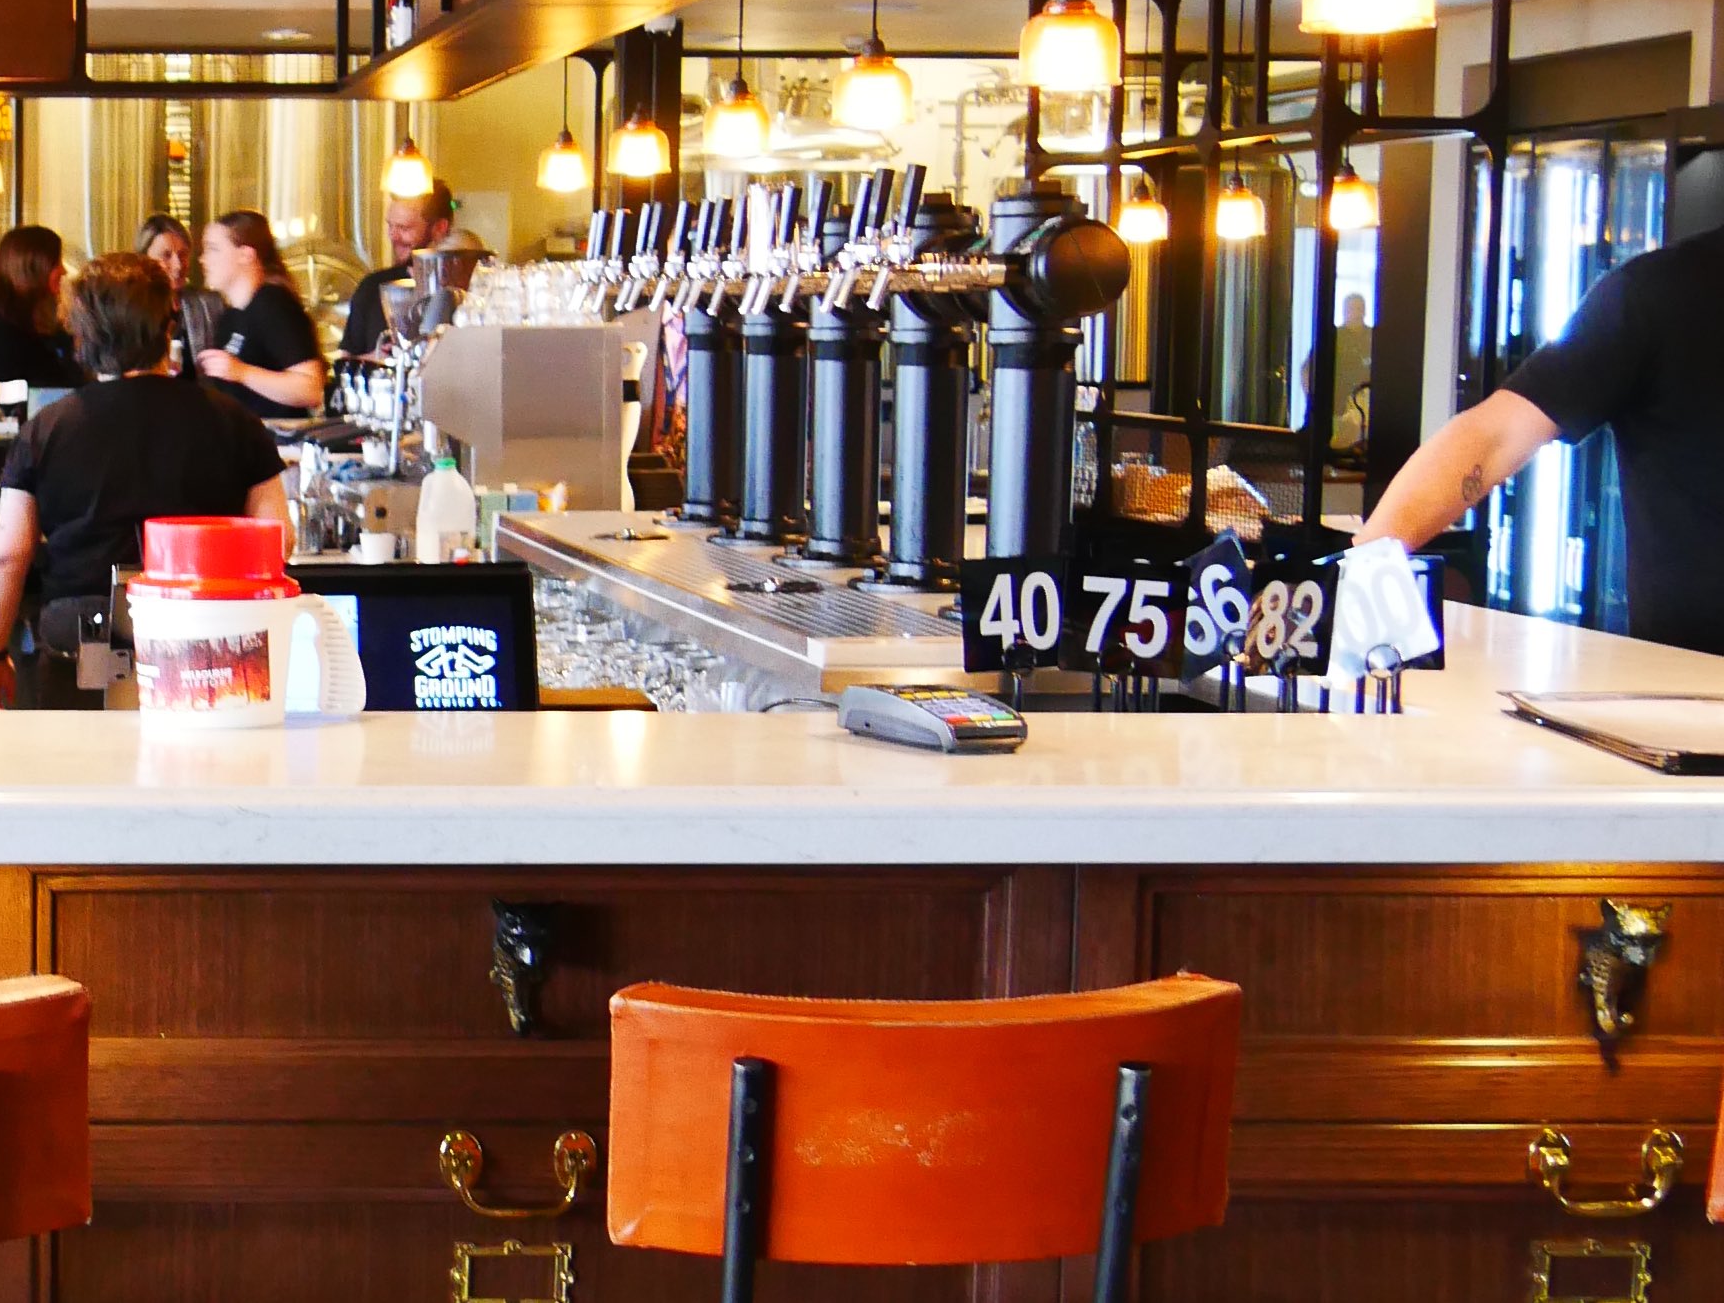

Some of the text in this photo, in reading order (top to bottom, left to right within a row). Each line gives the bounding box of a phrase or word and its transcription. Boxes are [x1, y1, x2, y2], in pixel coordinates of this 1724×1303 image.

[410, 625, 498, 653] STOMPING
[979, 571, 1061, 654] 40
[1082, 575, 1170, 659] 75
[1256, 579, 1323, 659] 82
[414, 674, 496, 698] GROUND
